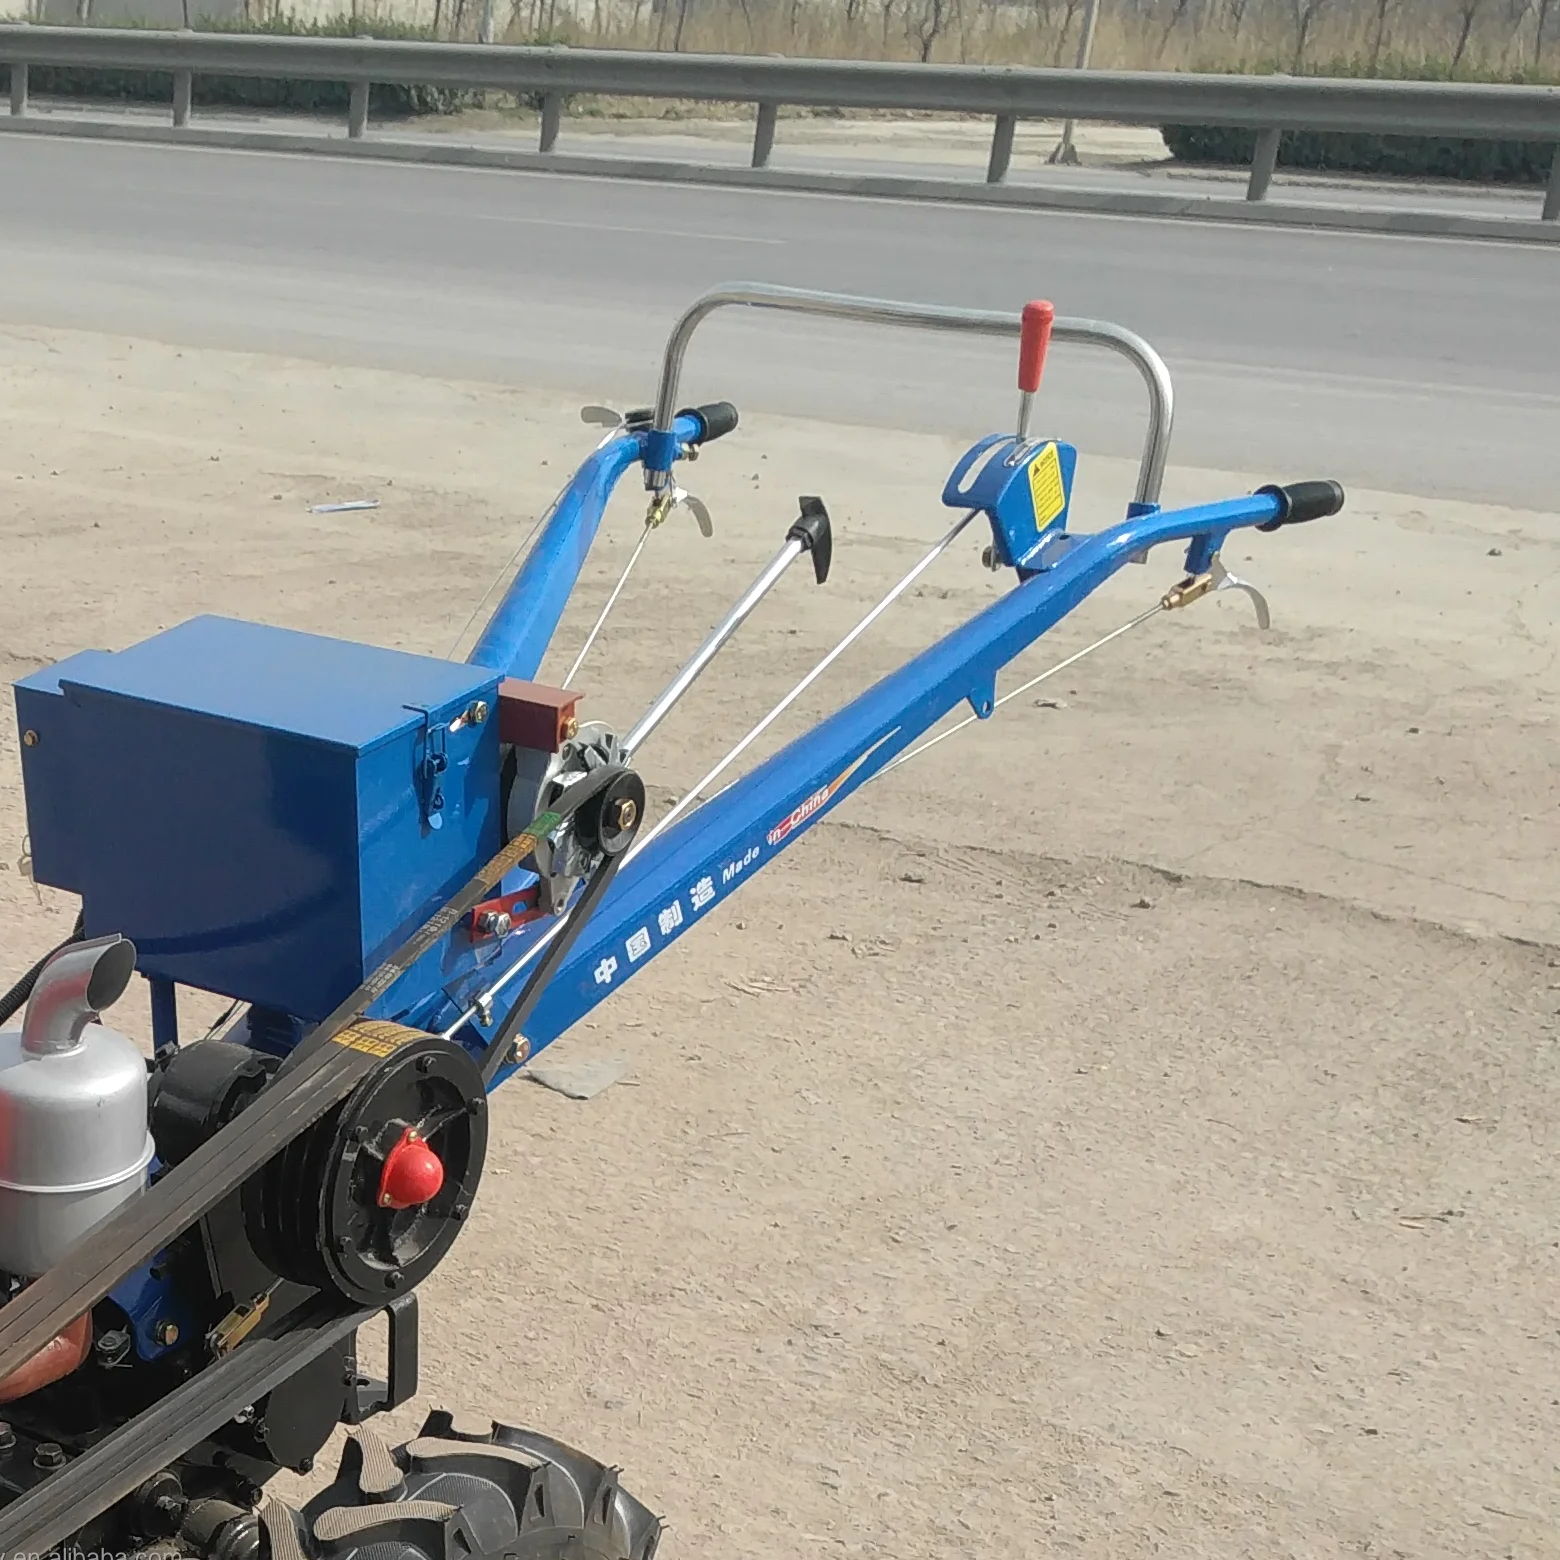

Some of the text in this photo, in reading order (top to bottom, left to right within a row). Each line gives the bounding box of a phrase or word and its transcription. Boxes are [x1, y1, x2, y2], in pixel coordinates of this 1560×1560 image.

[722, 846, 760, 884] Made
[790, 786, 829, 826] China
[593, 876, 715, 984] 中国制造
